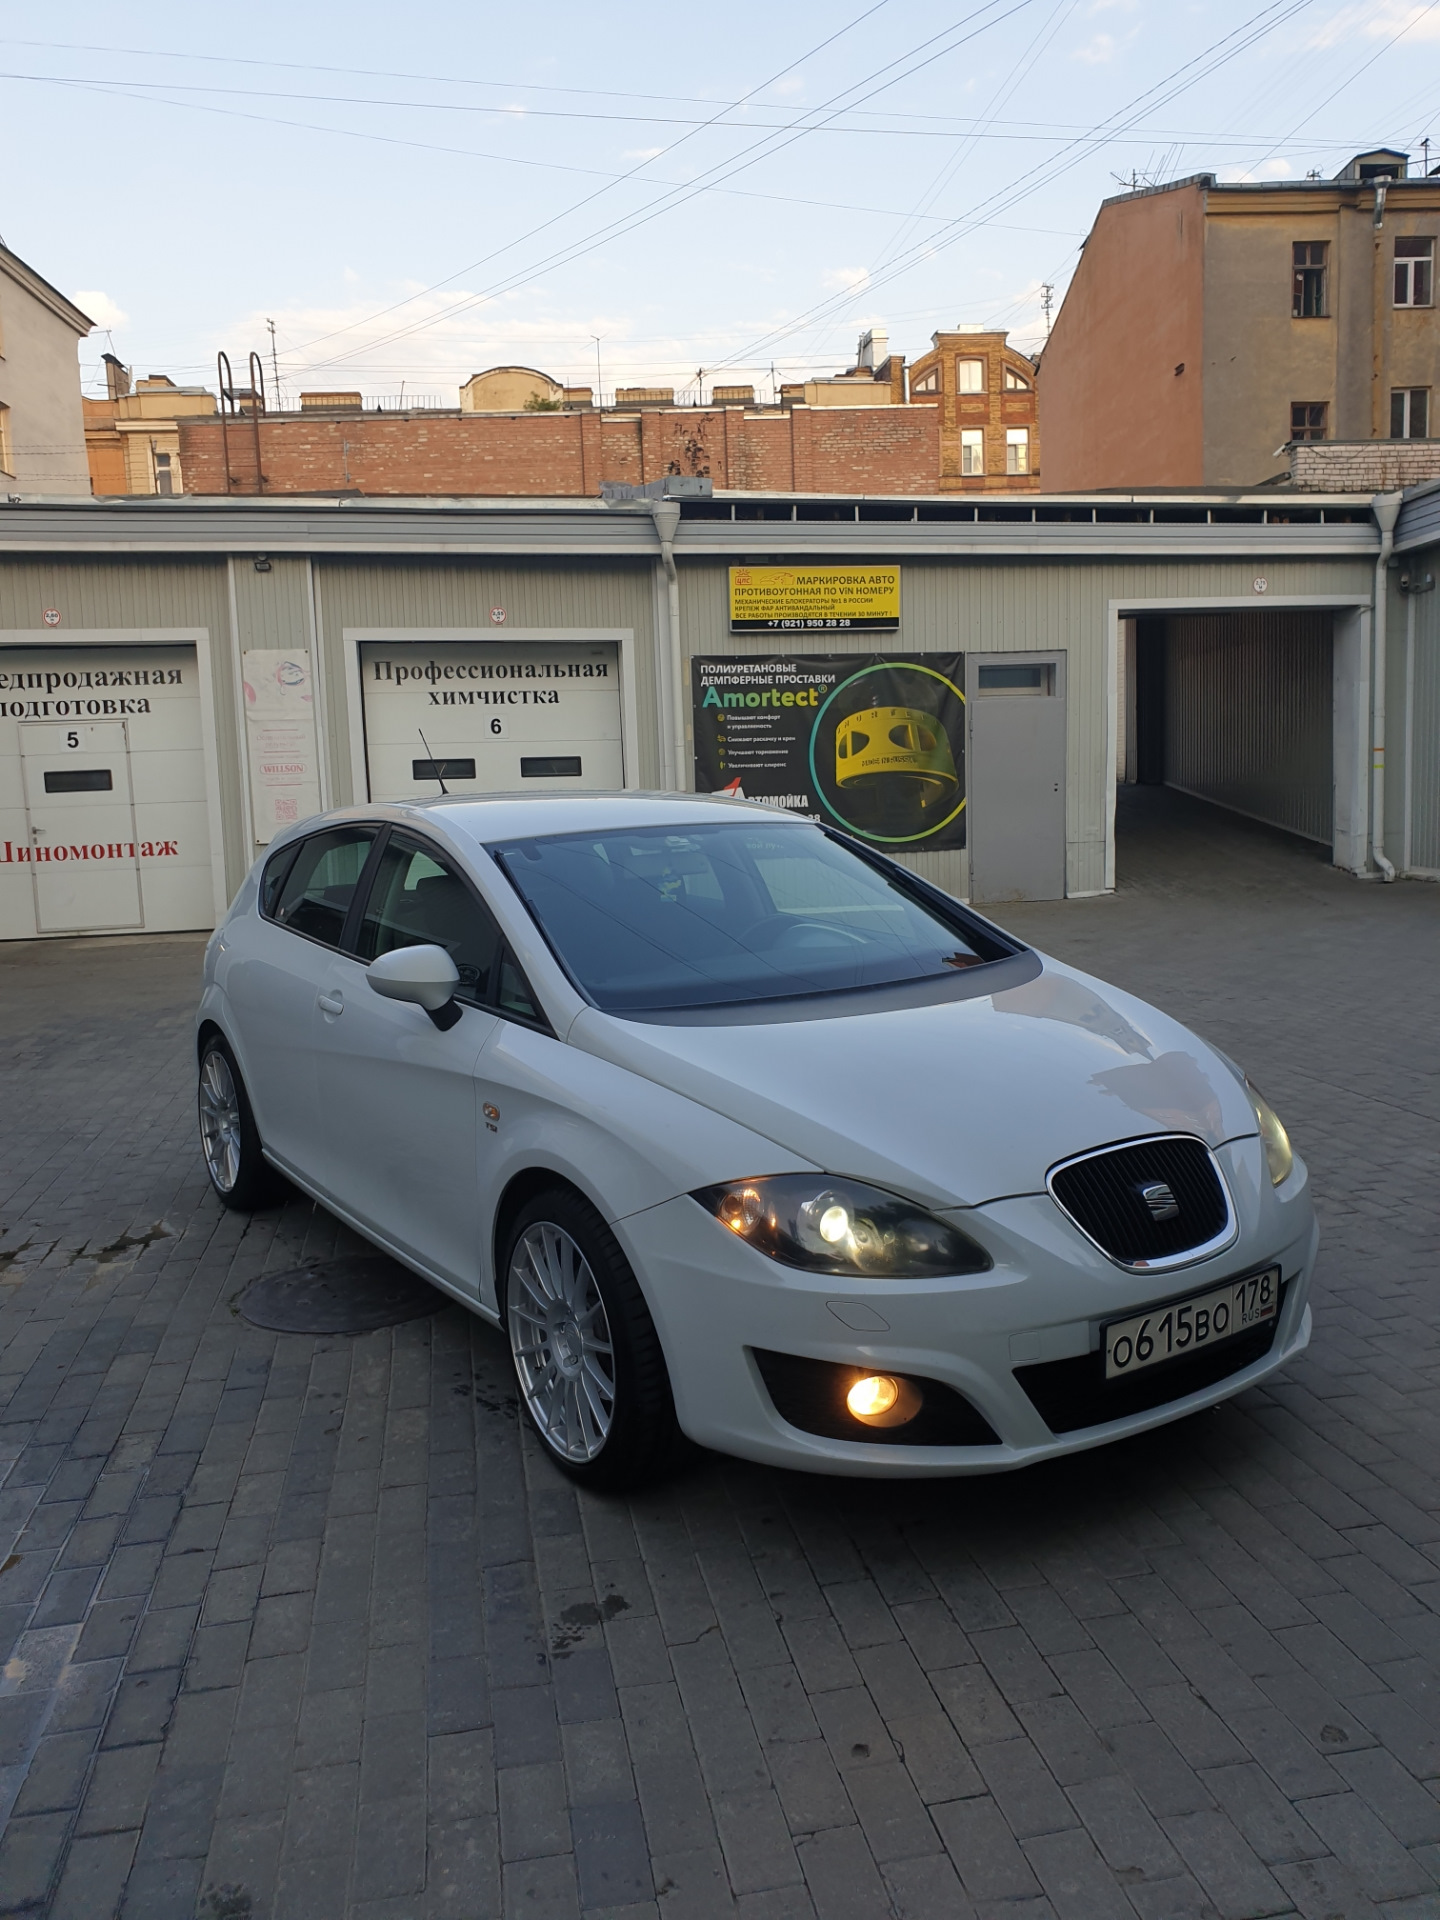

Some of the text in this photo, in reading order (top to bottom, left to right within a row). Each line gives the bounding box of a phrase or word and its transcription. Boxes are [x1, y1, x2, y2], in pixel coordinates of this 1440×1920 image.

[796, 575, 895, 585] МАРКИРОВКА АВТО
[734, 587, 821, 596] ПРОТИВОУГОННАЯ
[824, 587, 836, 596] ПО
[856, 586, 894, 595] НОМЕРУ
[781, 619, 804, 629] (921)
[839, 619, 850, 627] 28
[373, 660, 609, 686] Профессиональная
[700, 664, 797, 674] ПОЛИУРЕТАНОВЫЕ
[700, 674, 836, 687] ДЕМПФЕРНЫЕ ПРОСТАВКИ
[428, 689, 560, 706] химчистка
[702, 686, 818, 708] Amortect
[757, 714, 780, 722] комфорт
[490, 718, 502, 735] 6
[67, 732, 80, 748] 5
[264, 764, 304, 773] WILLSON
[1236, 1274, 1272, 1314] 178
[1242, 1308, 1260, 1325] RUS
